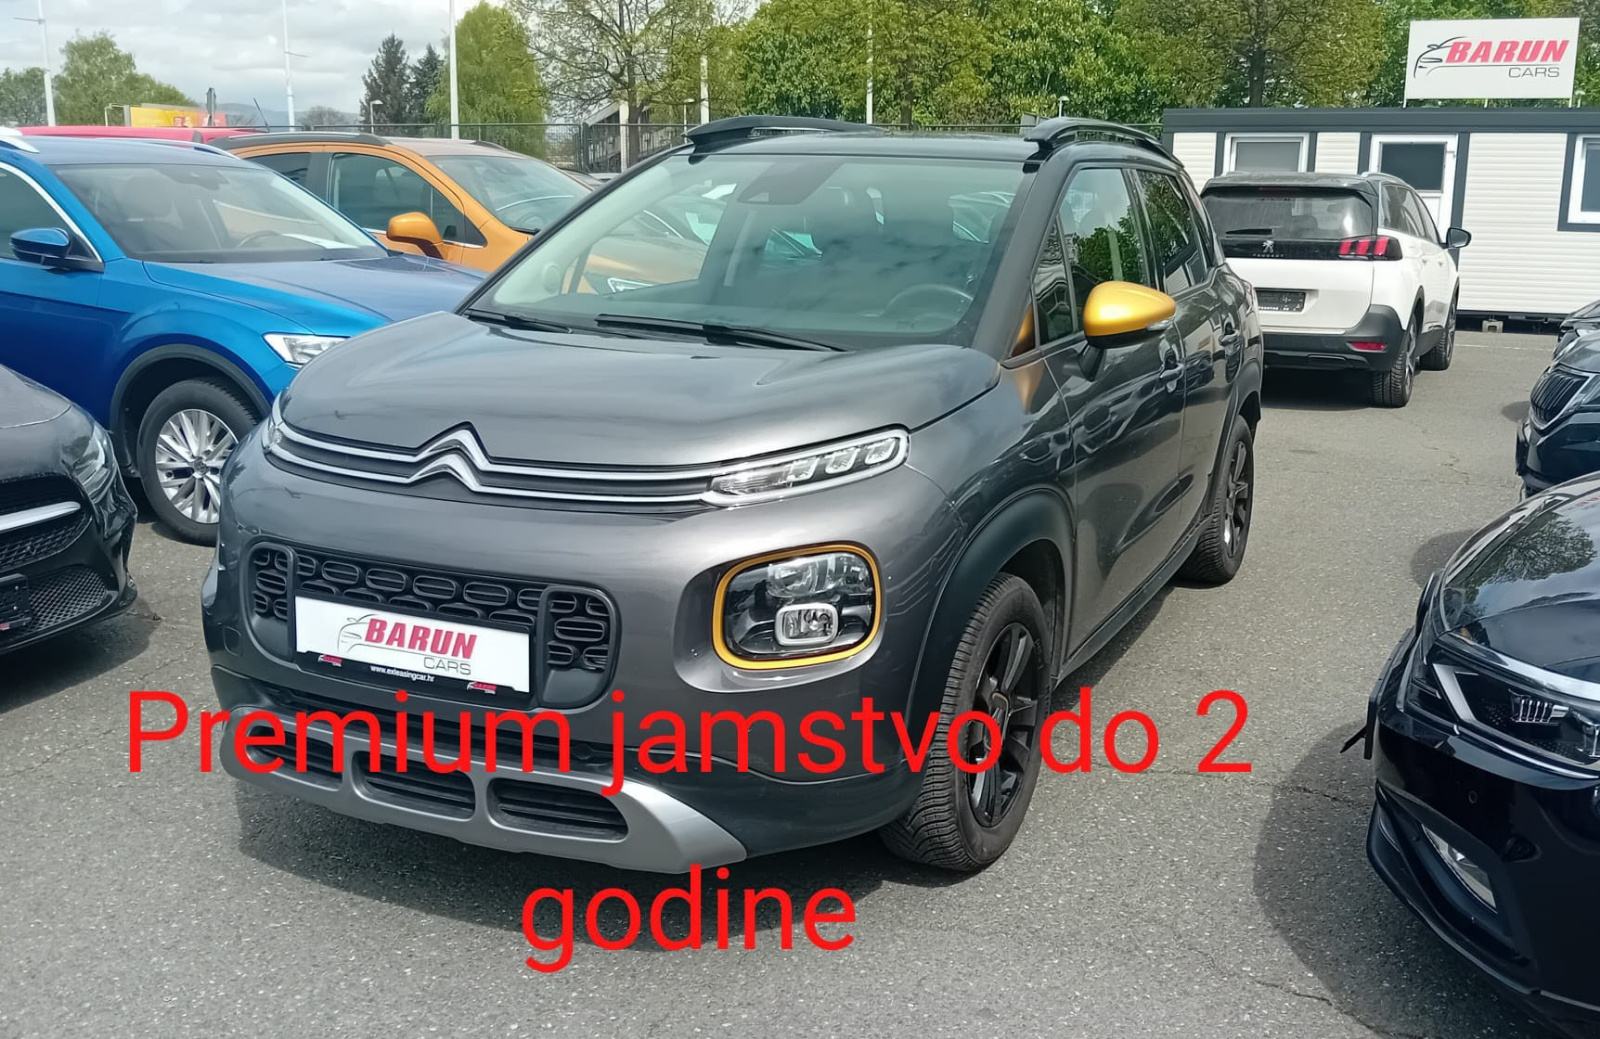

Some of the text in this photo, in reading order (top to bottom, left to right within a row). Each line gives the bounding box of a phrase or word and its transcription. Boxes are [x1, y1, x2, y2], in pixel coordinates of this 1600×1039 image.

[1445, 40, 1569, 64] BARUN
[1508, 66, 1560, 78] CARS
[365, 618, 478, 660] BARUN
[423, 656, 472, 676] CARS
